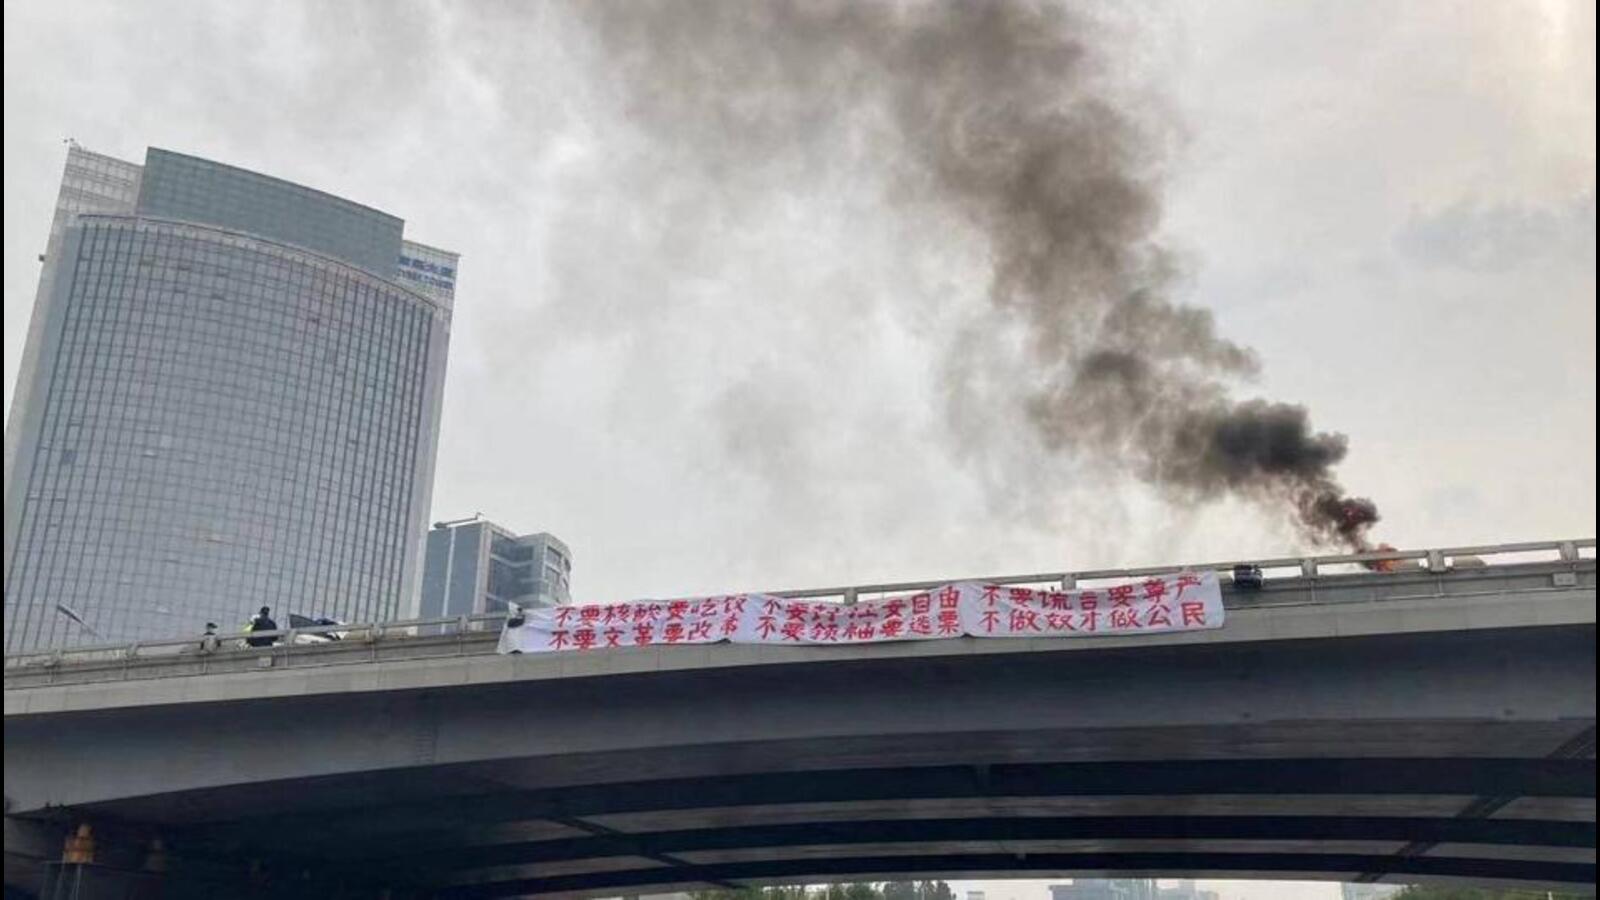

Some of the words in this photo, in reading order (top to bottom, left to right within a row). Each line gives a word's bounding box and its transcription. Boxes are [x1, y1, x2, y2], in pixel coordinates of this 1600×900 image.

[980, 576, 1202, 611] 不要谎言要尊严
[755, 610, 961, 641] 不要领袖要选票
[979, 601, 1206, 632] 不做奴才做公民
